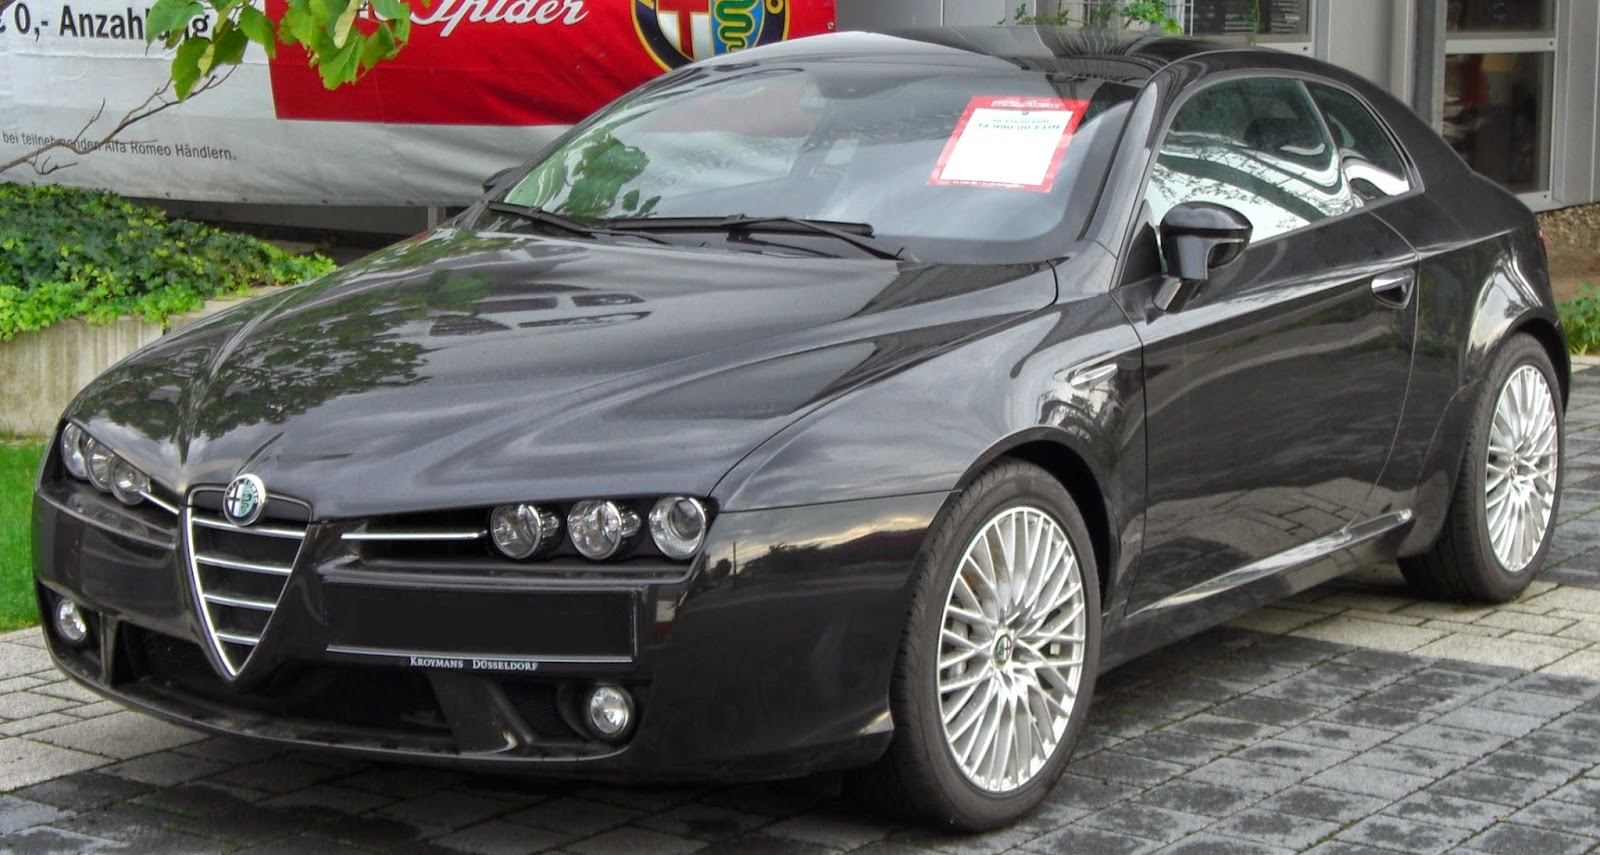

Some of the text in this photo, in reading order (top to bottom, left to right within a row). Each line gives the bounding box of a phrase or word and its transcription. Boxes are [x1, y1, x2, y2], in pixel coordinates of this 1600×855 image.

[59, 5, 210, 42] Anzahg
[2, 131, 19, 144] bei
[105, 140, 127, 154] Alfa
[131, 142, 172, 157] Romeo
[175, 143, 237, 160] Händlern.
[410, 656, 539, 671] KROYMANS DÜSSELDORF
